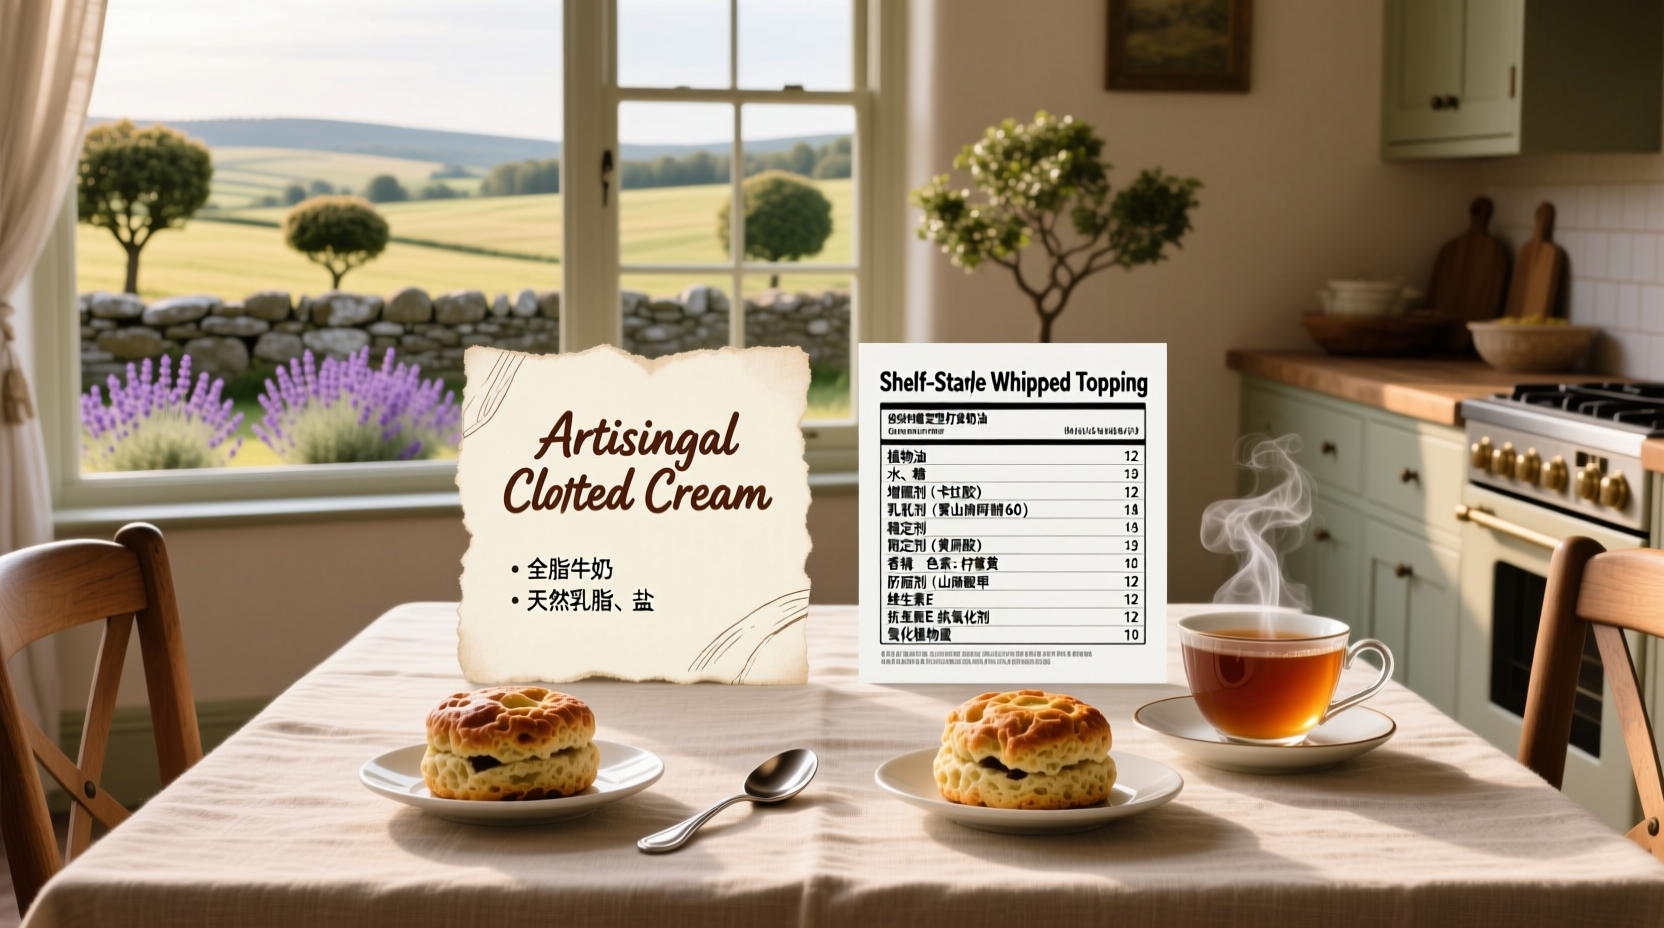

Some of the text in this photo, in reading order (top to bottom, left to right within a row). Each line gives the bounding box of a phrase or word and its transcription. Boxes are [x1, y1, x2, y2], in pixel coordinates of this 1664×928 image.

[991, 371, 1070, 397] Whipped
[1076, 371, 1148, 397] Topping
[534, 410, 740, 471] Artisingal
[1125, 450, 1139, 462] 12
[645, 467, 773, 514] Cream
[1125, 486, 1139, 498] 12
[527, 557, 613, 581] 全脂牛奶
[1125, 557, 1138, 569] 10
[1124, 576, 1139, 588] 12
[527, 588, 654, 612] 天然乳脂、盐
[1124, 593, 1139, 606] 12
[1124, 611, 1139, 623] 12
[1124, 629, 1139, 641] 10
